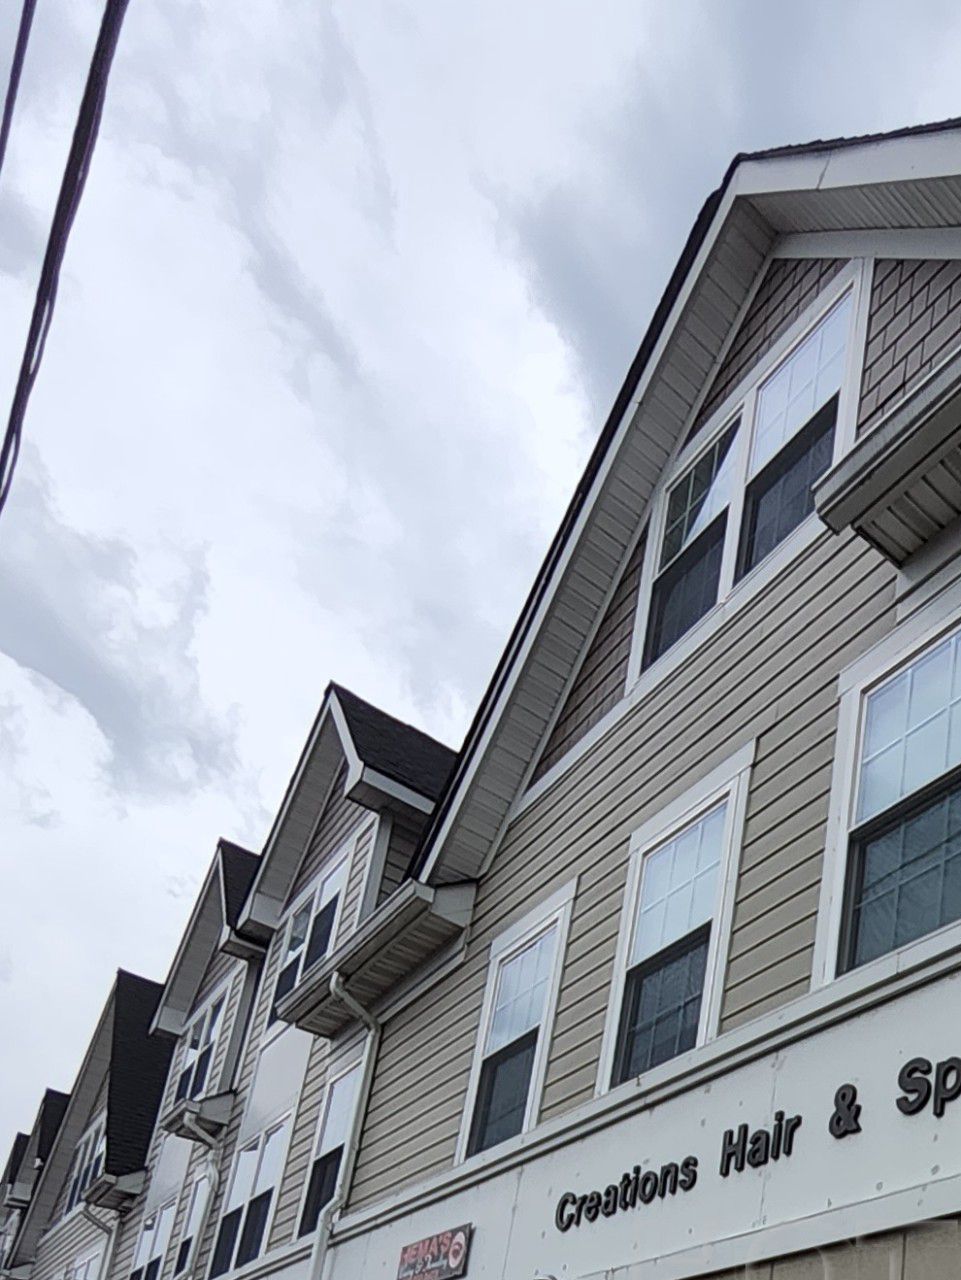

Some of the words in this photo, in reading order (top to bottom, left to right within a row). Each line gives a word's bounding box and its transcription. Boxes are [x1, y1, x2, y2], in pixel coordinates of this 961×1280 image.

[555, 1156, 698, 1232] Creations
[719, 1111, 802, 1177] Hair
[829, 1083, 862, 1139] &
